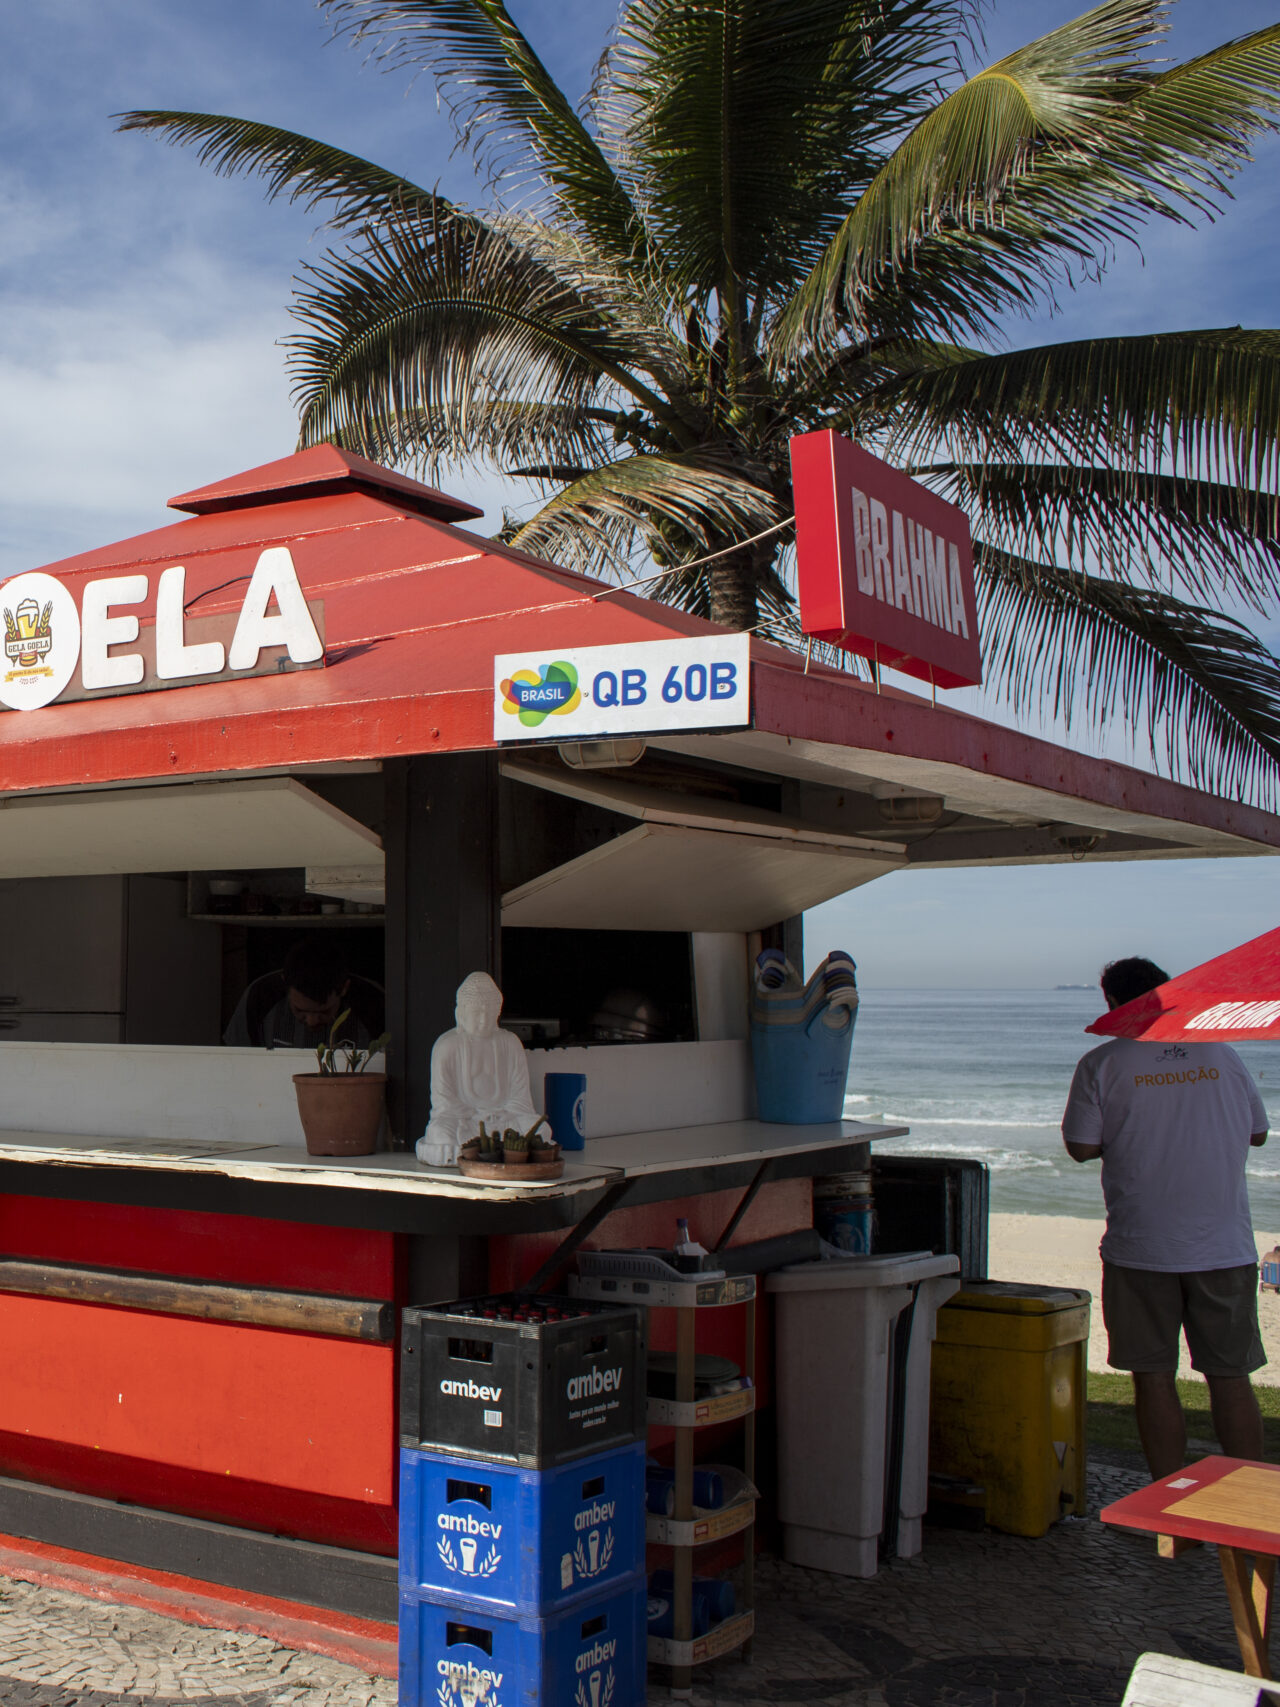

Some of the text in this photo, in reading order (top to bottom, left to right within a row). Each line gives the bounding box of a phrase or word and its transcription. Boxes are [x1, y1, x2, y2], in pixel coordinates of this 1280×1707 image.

[851, 486, 970, 640] BRAHMA
[8, 639, 49, 653] GELA GOELA
[521, 688, 566, 703] BRASIL
[592, 661, 738, 708] QB 60B
[1134, 1066, 1220, 1087] PRODUÇÃO
[440, 1379, 502, 1402] ambev
[566, 1365, 623, 1401] ambev
[437, 1513, 503, 1539] ambev
[574, 1501, 616, 1531] ambev
[575, 1639, 617, 1674] ambev
[437, 1659, 503, 1688] ambev
